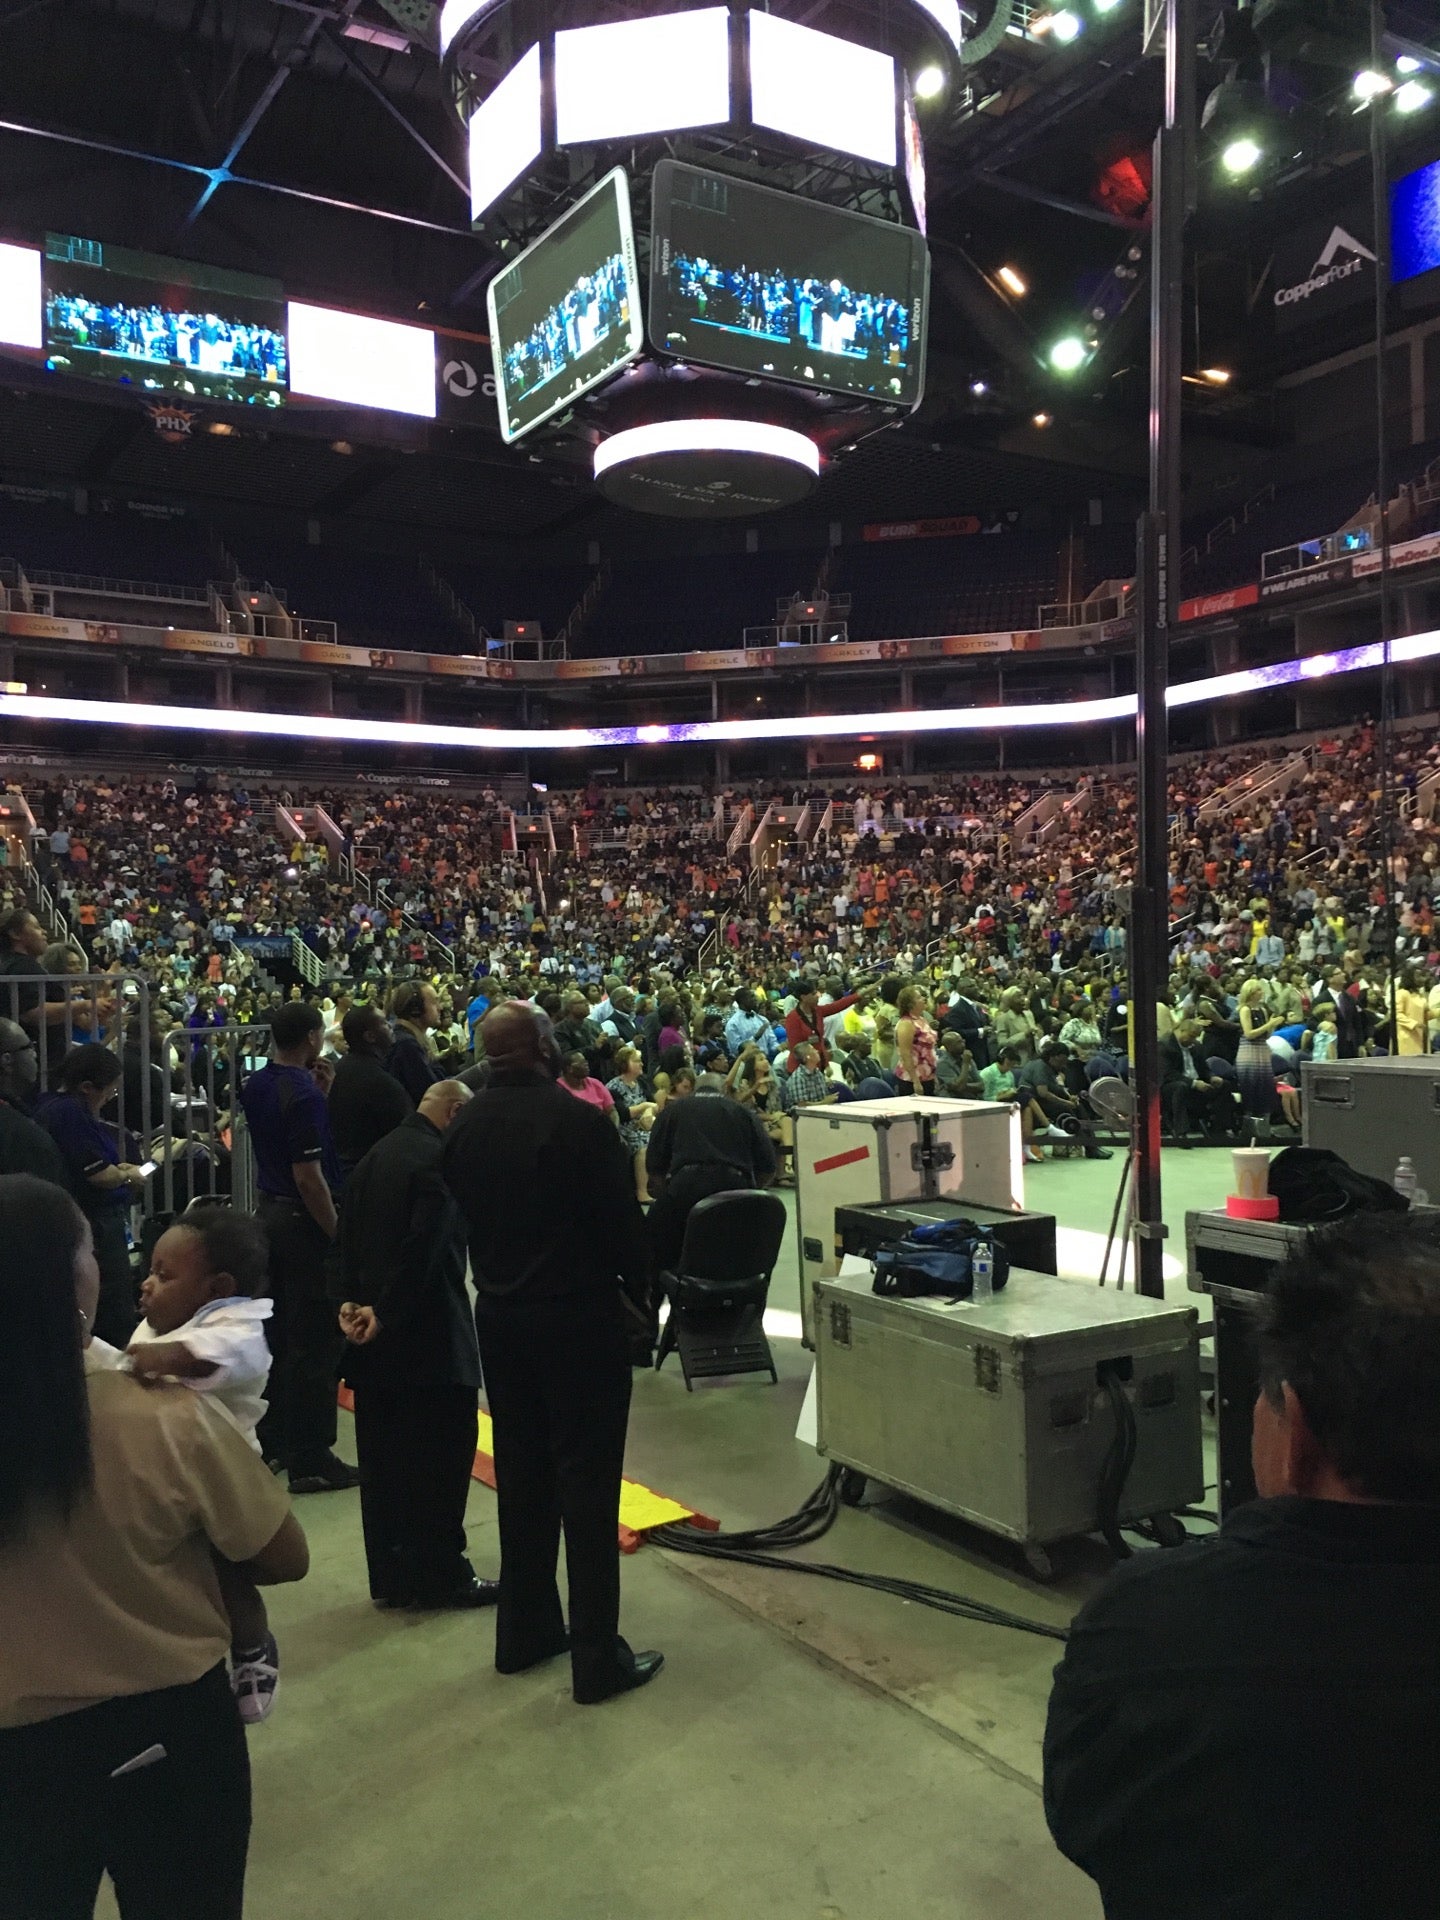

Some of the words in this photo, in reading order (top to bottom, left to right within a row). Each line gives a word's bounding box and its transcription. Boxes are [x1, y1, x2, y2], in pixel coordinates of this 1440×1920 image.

[661, 238, 670, 276] verizon
[1273, 258, 1363, 306] CopperPoint
[910, 297, 922, 342] verizon
[155, 416, 191, 433] PHX
